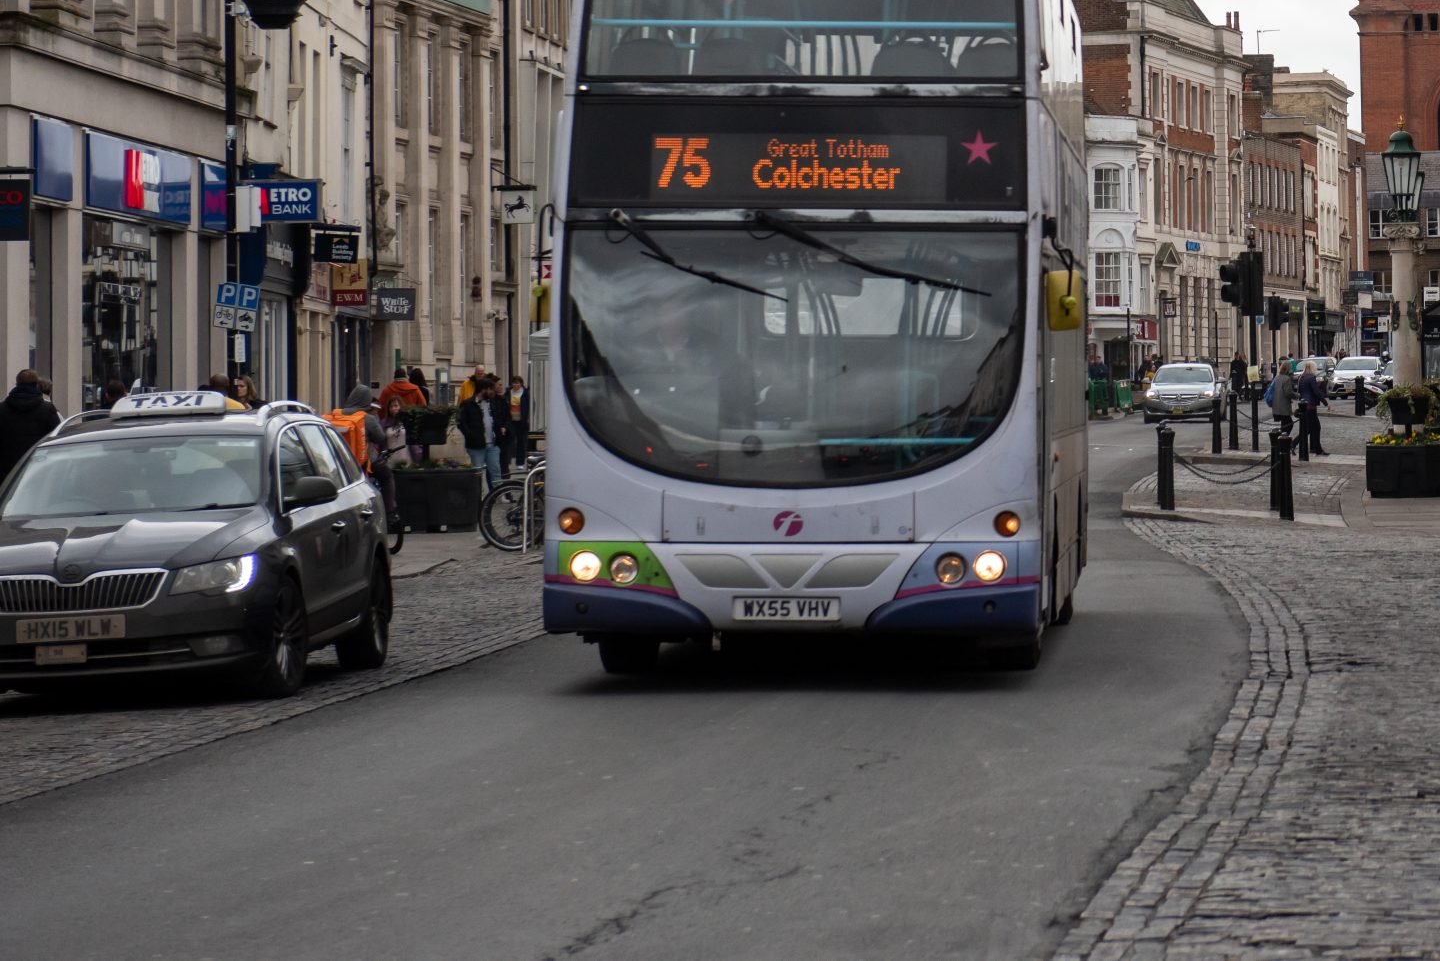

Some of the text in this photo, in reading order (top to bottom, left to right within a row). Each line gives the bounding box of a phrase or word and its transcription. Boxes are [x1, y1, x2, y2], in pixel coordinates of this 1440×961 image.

[767, 138, 890, 159] Great Totham
[654, 137, 711, 189] 75
[752, 158, 901, 191] Colchester
[272, 203, 312, 215] BANK
[221, 285, 235, 303] P
[242, 287, 257, 306] P
[336, 293, 363, 302] EWM
[130, 394, 204, 409] TAXI
[743, 600, 831, 617] WX55 VHV
[27, 619, 112, 639] HX15 WLW
